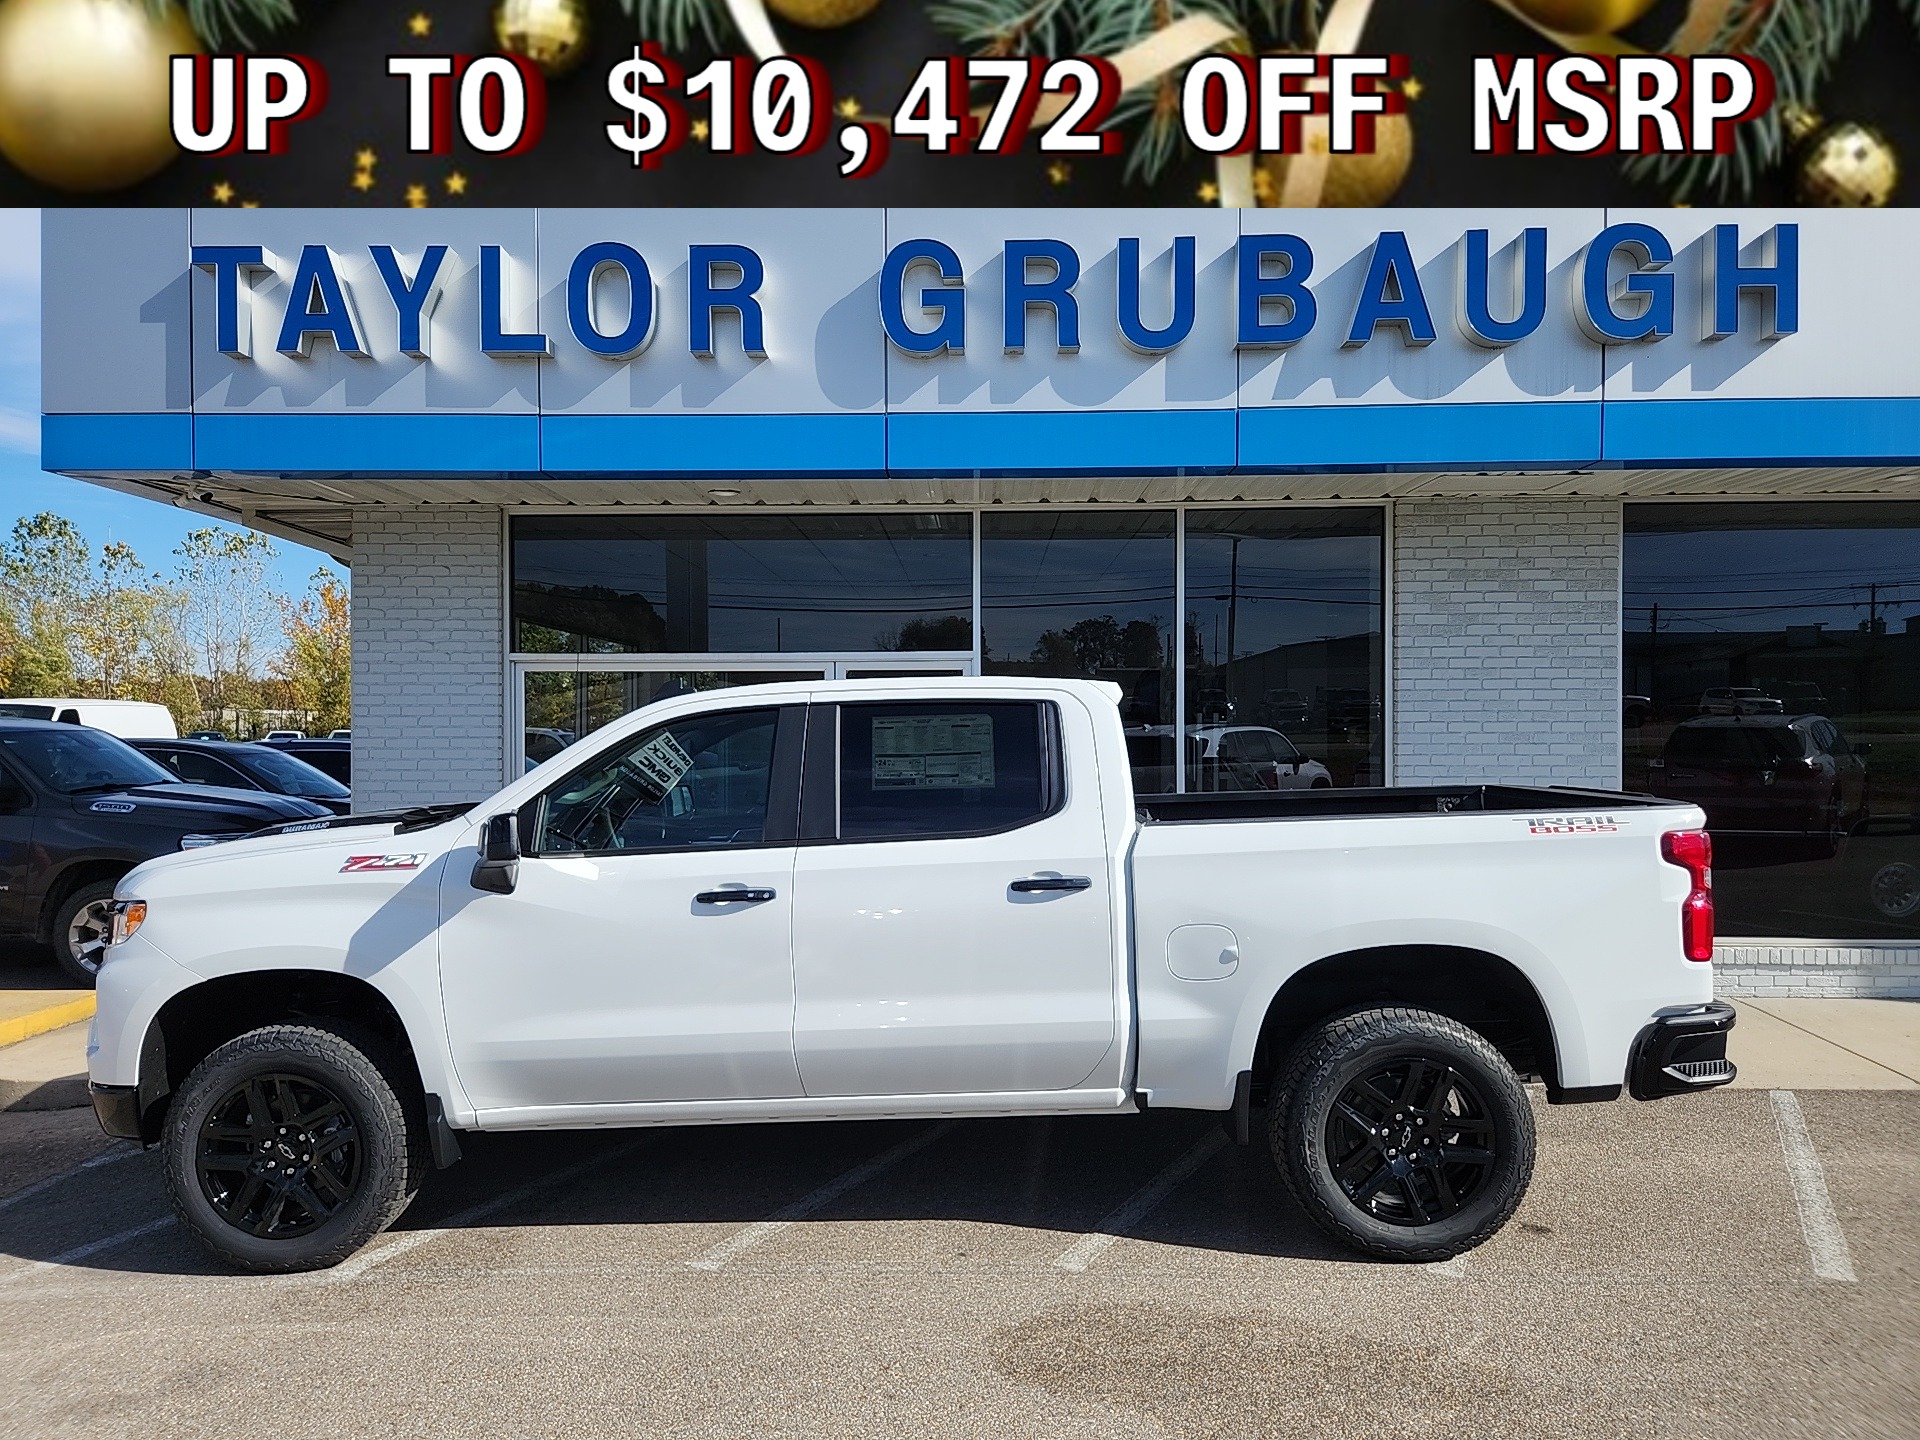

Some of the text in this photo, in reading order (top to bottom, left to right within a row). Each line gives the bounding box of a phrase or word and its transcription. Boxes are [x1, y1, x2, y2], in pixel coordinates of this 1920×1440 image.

[191, 223, 1798, 359] TAYLOR GRUBAUGH
[1511, 815, 1631, 827] TRAIL
[1529, 825, 1618, 834] BOSS
[338, 852, 428, 873] Z71
